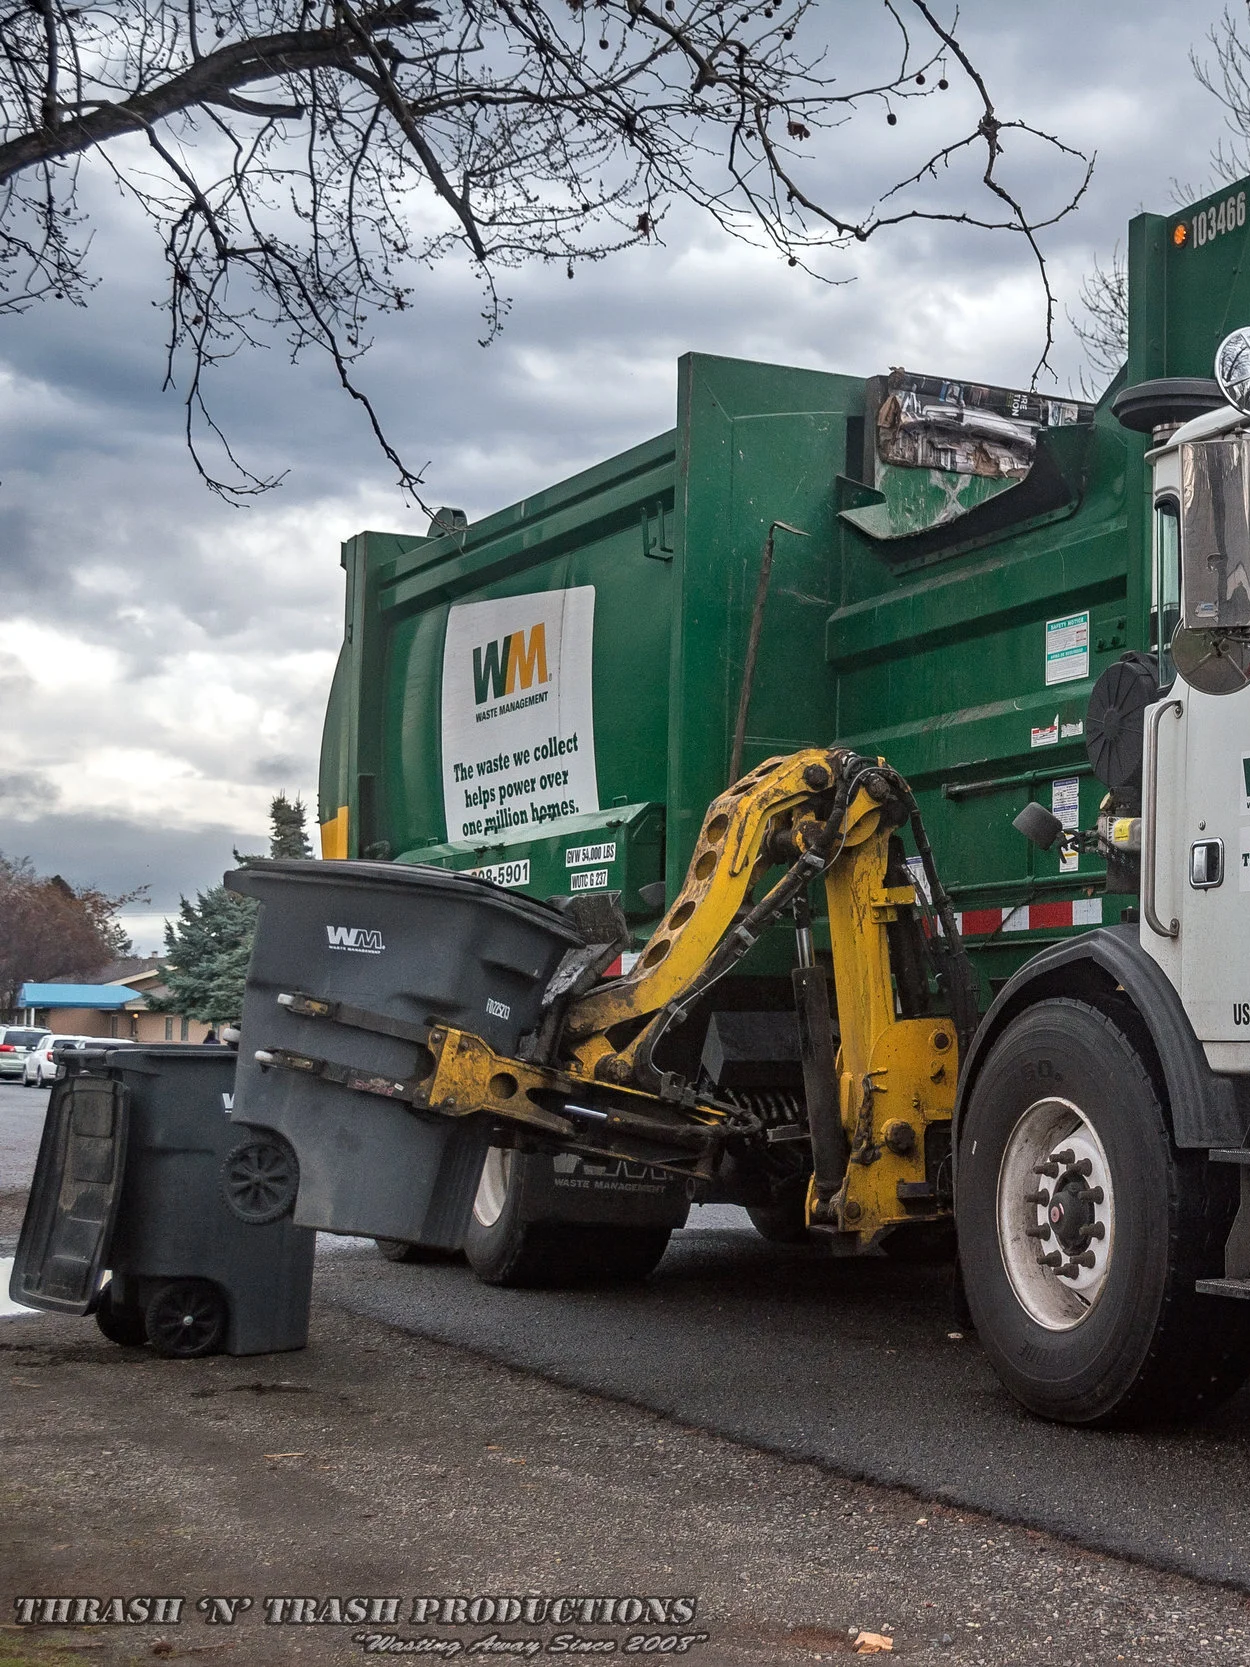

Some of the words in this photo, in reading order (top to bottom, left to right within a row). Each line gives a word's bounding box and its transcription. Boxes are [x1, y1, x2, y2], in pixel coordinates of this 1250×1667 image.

[1191, 191, 1246, 249] 103466
[472, 621, 549, 706] WM
[475, 707, 498, 723] WASTE
[498, 690, 549, 716] MANAGEMENT
[453, 762, 474, 783] The
[476, 752, 510, 777] waste
[512, 749, 530, 767] we
[533, 731, 579, 762] collect
[464, 785, 496, 810] helps
[498, 777, 537, 806] power
[539, 769, 569, 791] over
[462, 819, 483, 837] one
[484, 807, 529, 836] million
[530, 799, 580, 824] homes.
[566, 849, 581, 864] GVW
[603, 844, 615, 859] LBS
[471, 862, 528, 885] 8-5901
[571, 873, 588, 889] WUTC
[589, 872, 595, 887] G
[595, 871, 607, 886] 237
[326, 925, 383, 950] WM
[554, 1178, 590, 1189] WASTE
[594, 1181, 666, 1194] MANAGEMENT
